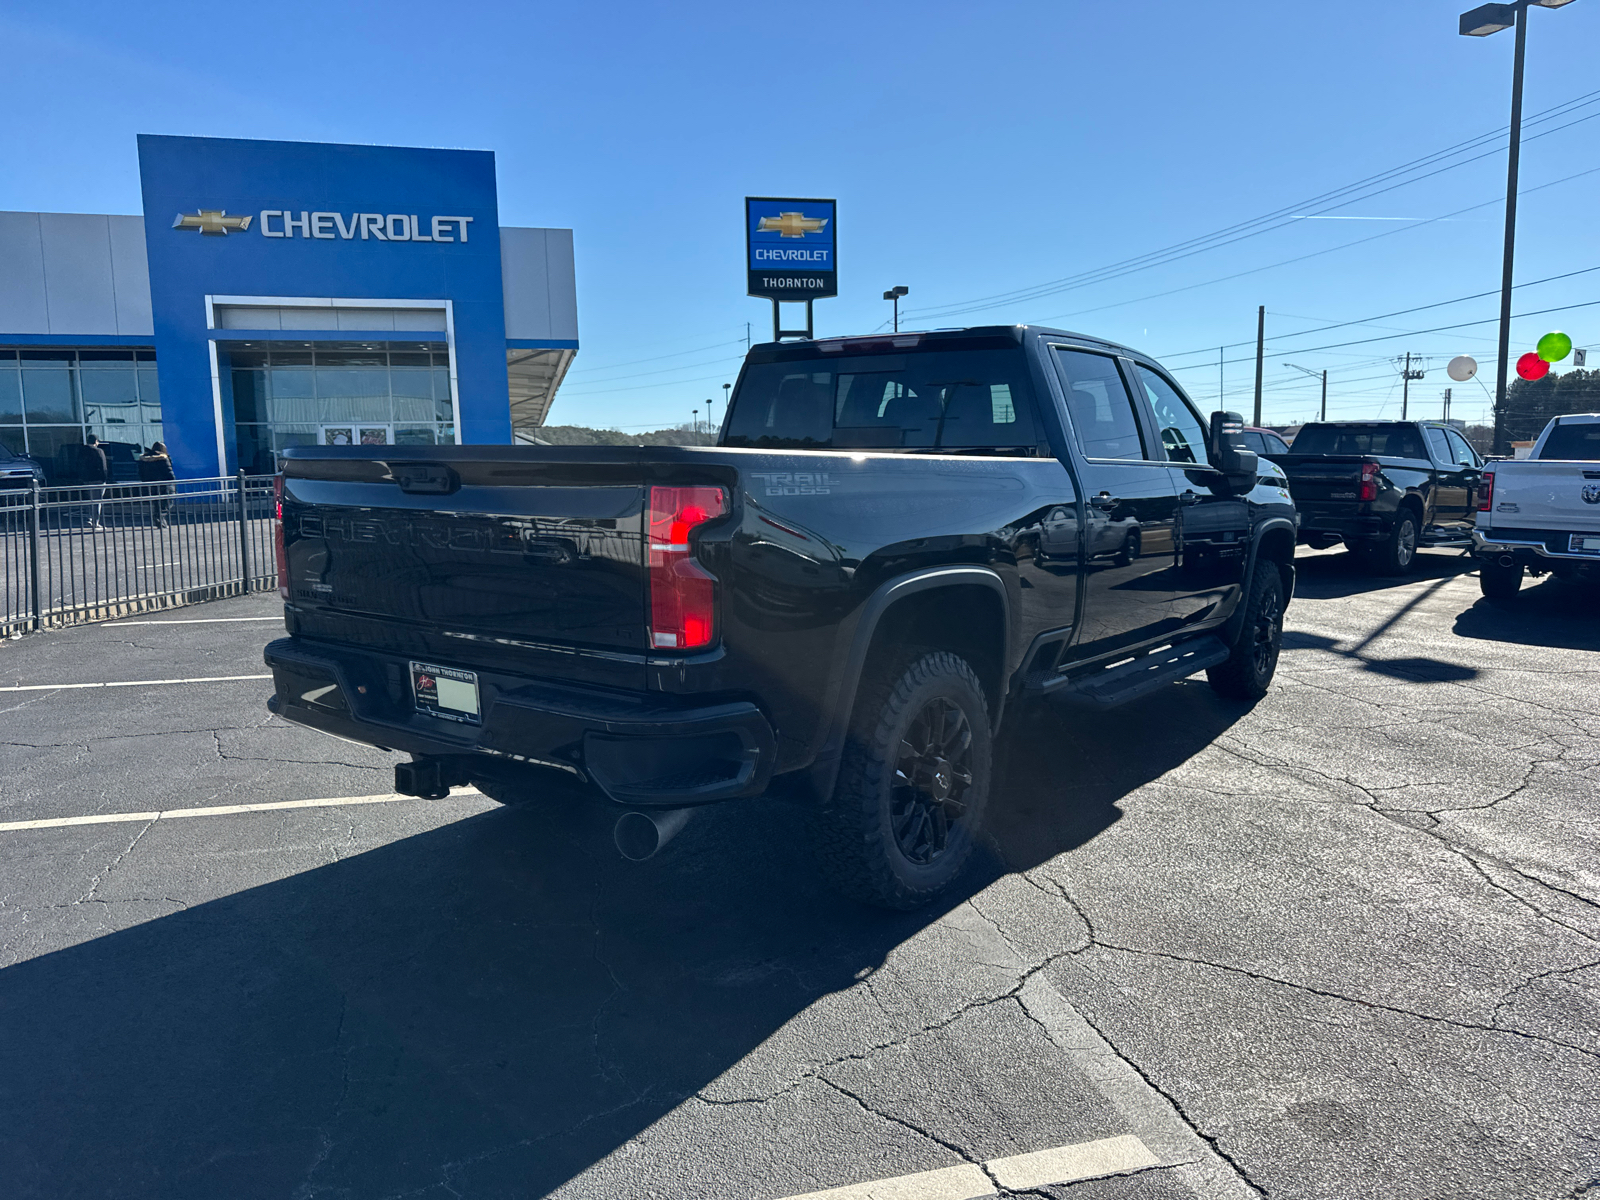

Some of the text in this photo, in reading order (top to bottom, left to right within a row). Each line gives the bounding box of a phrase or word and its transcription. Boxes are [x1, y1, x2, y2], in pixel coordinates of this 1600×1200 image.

[260, 210, 474, 242] CHEVROLET
[755, 249, 829, 261] CHEVROLET
[763, 277, 824, 288] THORNTON
[751, 473, 840, 486] TRAIL
[765, 486, 831, 496] BOSS
[425, 666, 473, 680] JOHN THORNTON
